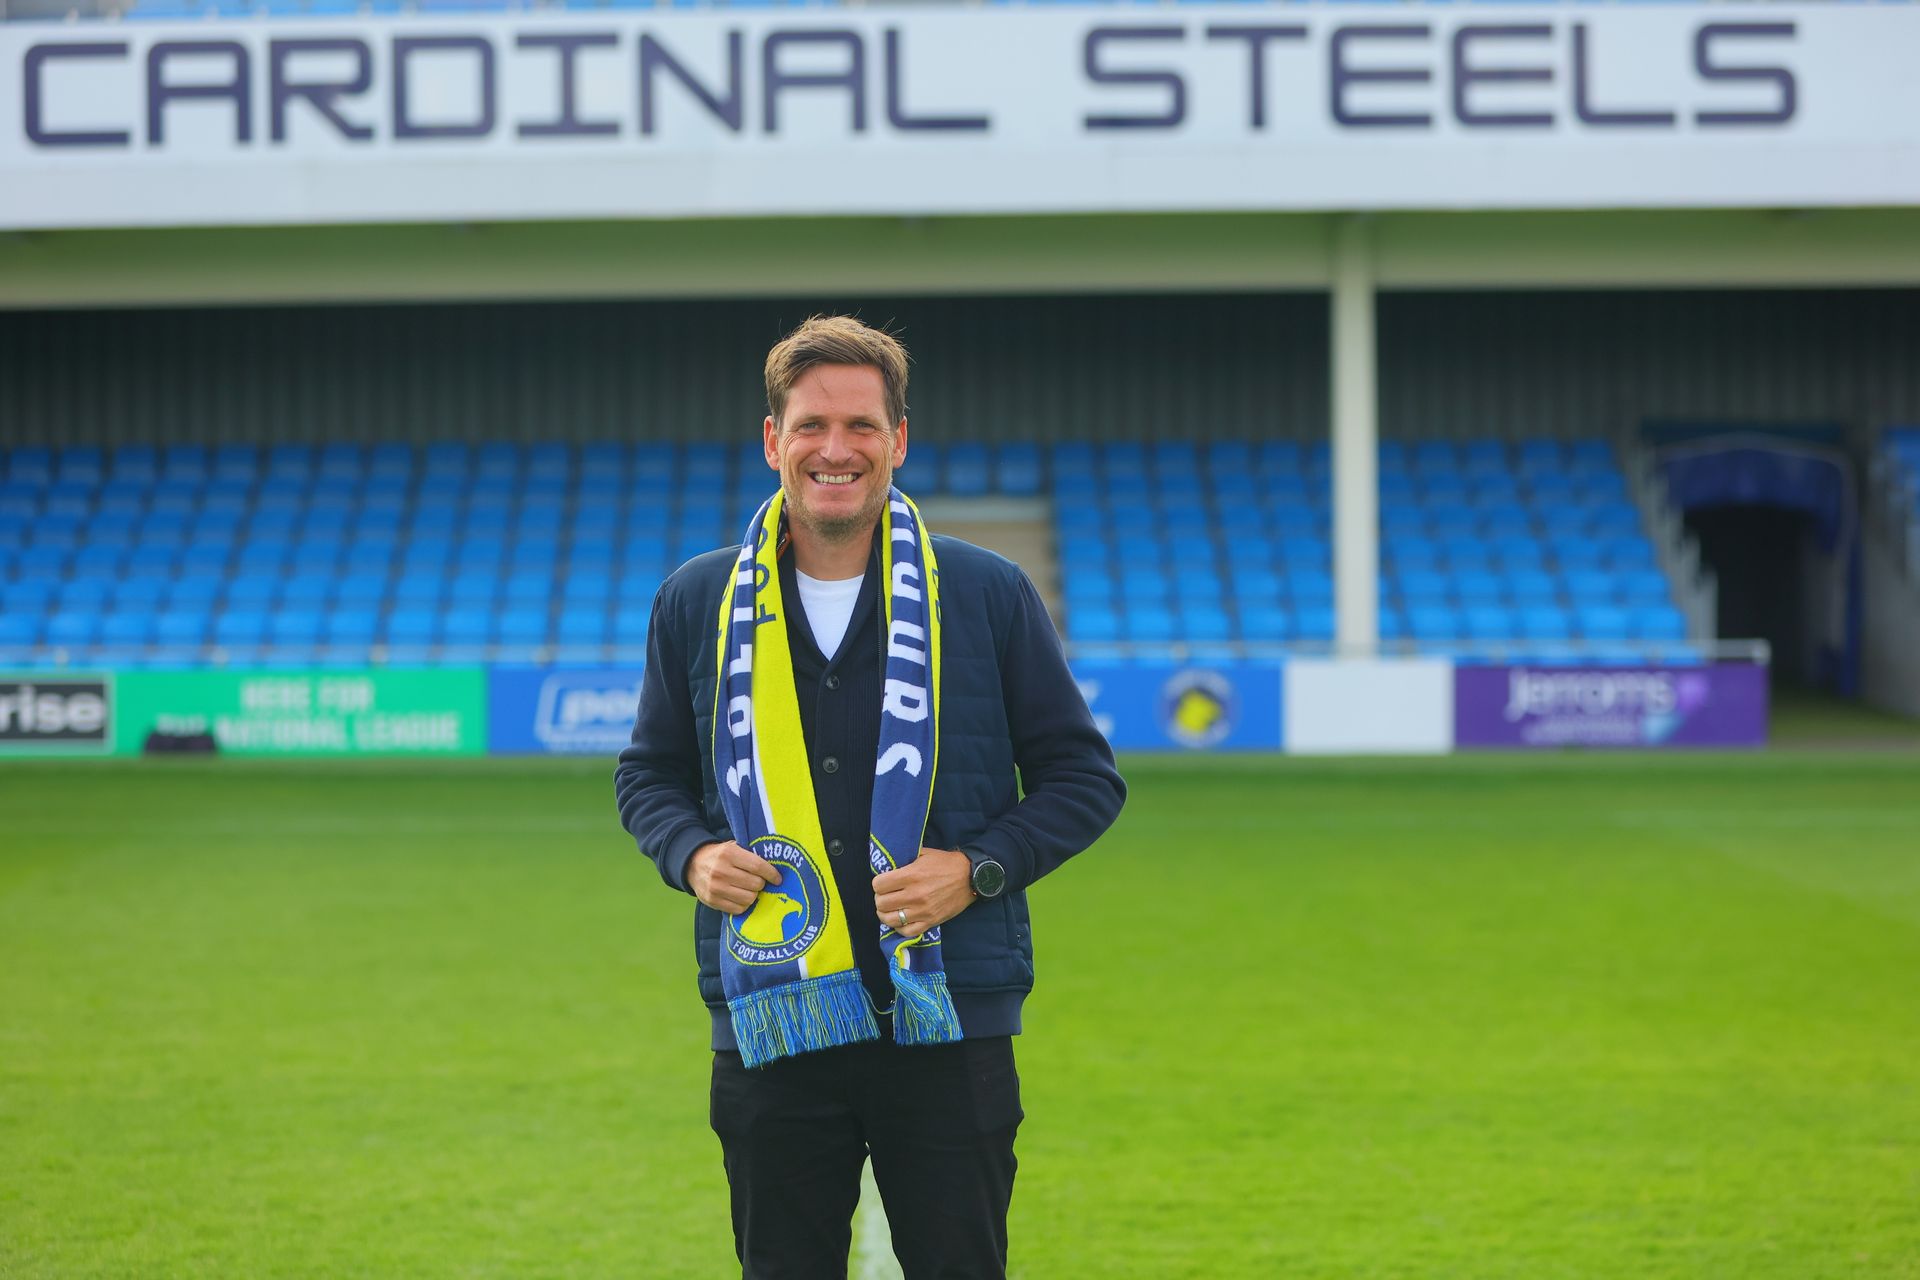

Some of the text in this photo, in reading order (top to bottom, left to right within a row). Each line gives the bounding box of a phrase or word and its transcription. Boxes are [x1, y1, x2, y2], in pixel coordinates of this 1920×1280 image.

[23, 23, 1798, 147] CARDINAL STEELS
[763, 842, 804, 868] MOORS
[732, 924, 819, 961] FOOTBALL CLUB
